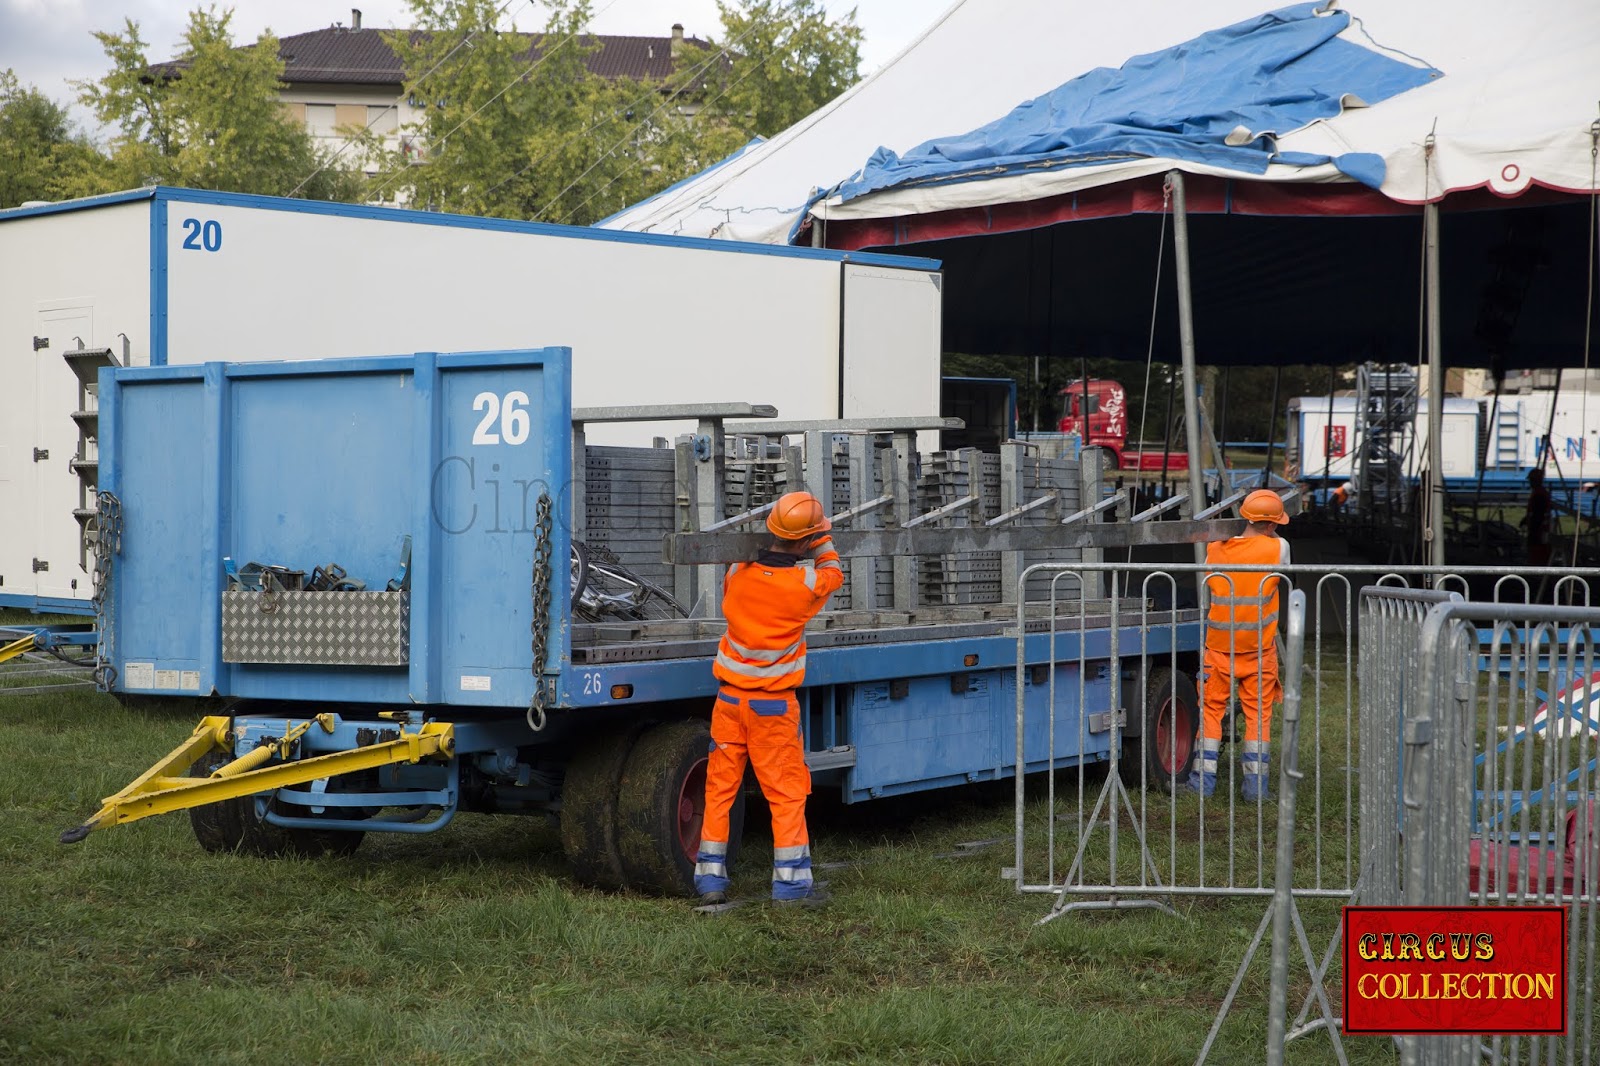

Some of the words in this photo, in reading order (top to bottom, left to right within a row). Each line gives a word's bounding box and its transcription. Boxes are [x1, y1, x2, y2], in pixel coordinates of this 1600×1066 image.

[182, 218, 222, 252] 20
[472, 391, 531, 446] 26
[583, 673, 602, 695] 26
